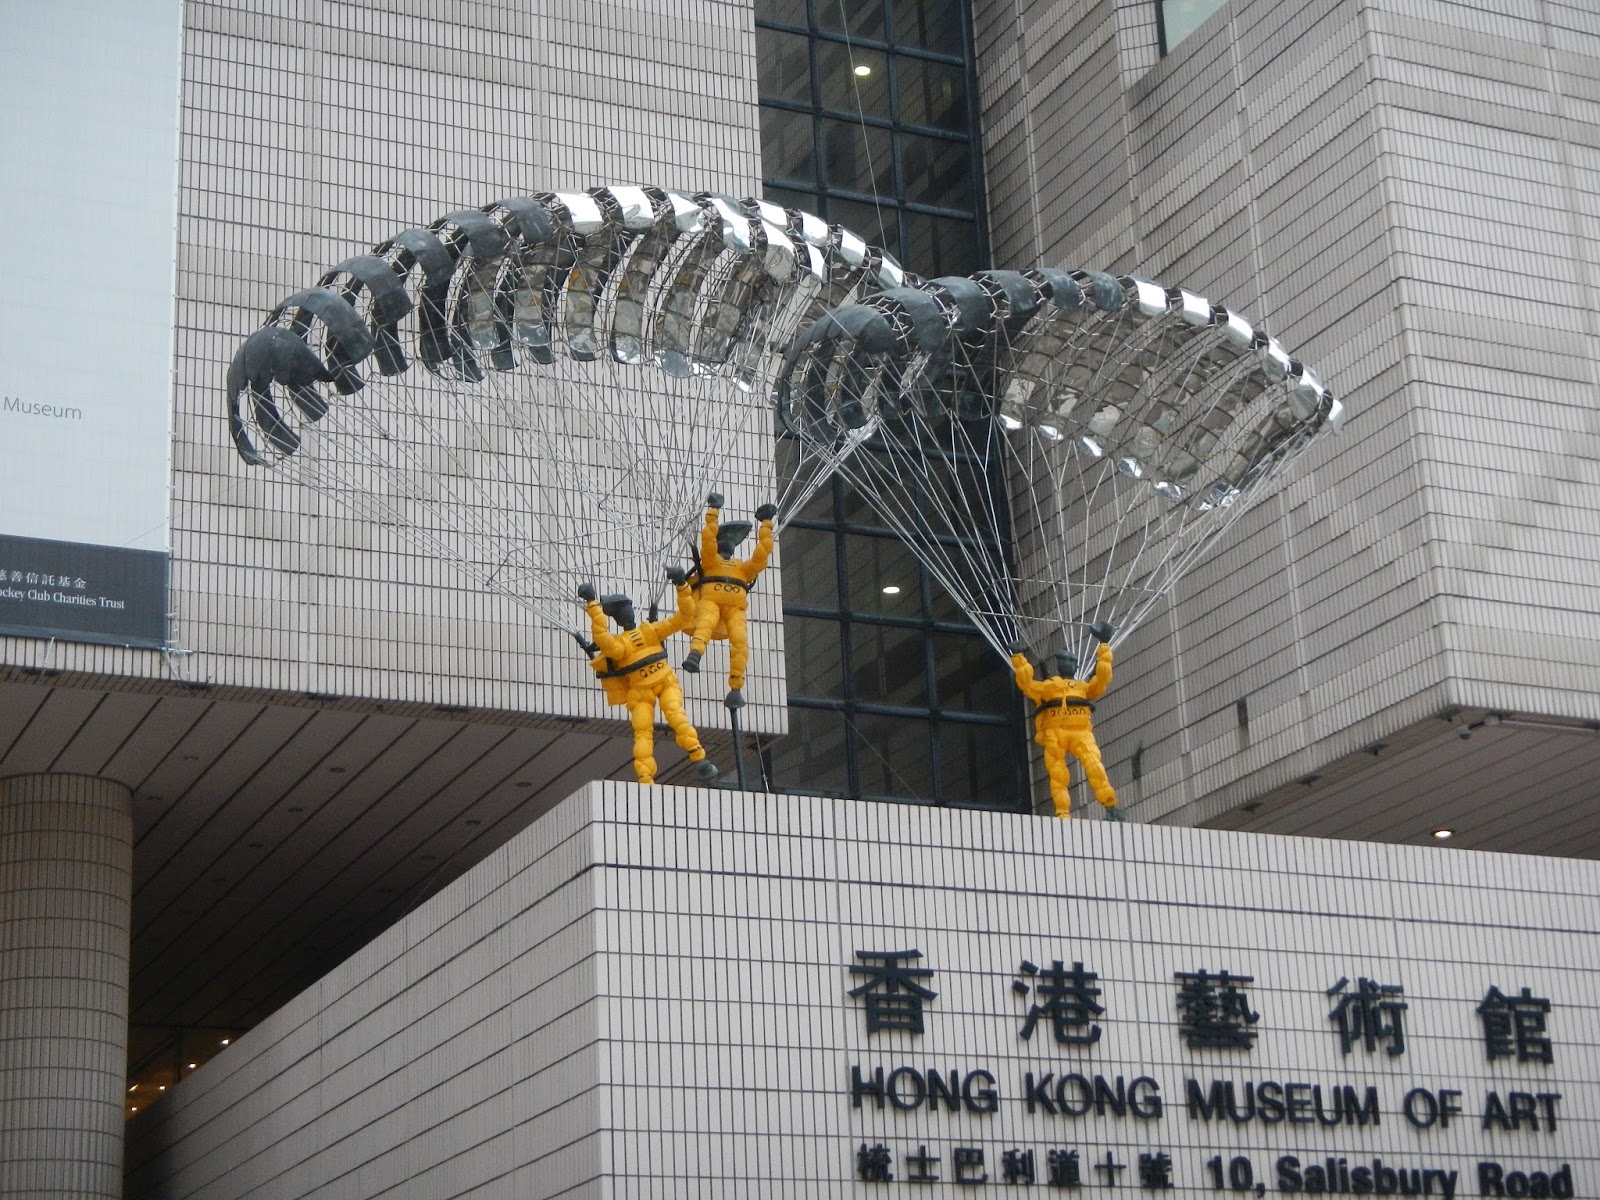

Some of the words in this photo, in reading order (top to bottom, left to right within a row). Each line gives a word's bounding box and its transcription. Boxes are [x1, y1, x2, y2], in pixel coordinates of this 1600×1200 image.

[4, 396, 82, 420] Museum
[27, 589, 50, 601] Club
[53, 592, 97, 606] Charities
[99, 596, 125, 609] Trust
[847, 948, 1554, 1064] 香港藝術館
[852, 1065, 998, 1113] HONG
[1025, 1071, 1163, 1119] KONG
[1188, 1078, 1381, 1126] MUSEUM
[1403, 1087, 1463, 1129] OF
[1482, 1091, 1562, 1132] ART
[1207, 1155, 1266, 1198] 10,
[1276, 1155, 1458, 1200] Salisbury
[1477, 1161, 1575, 1200] Road
